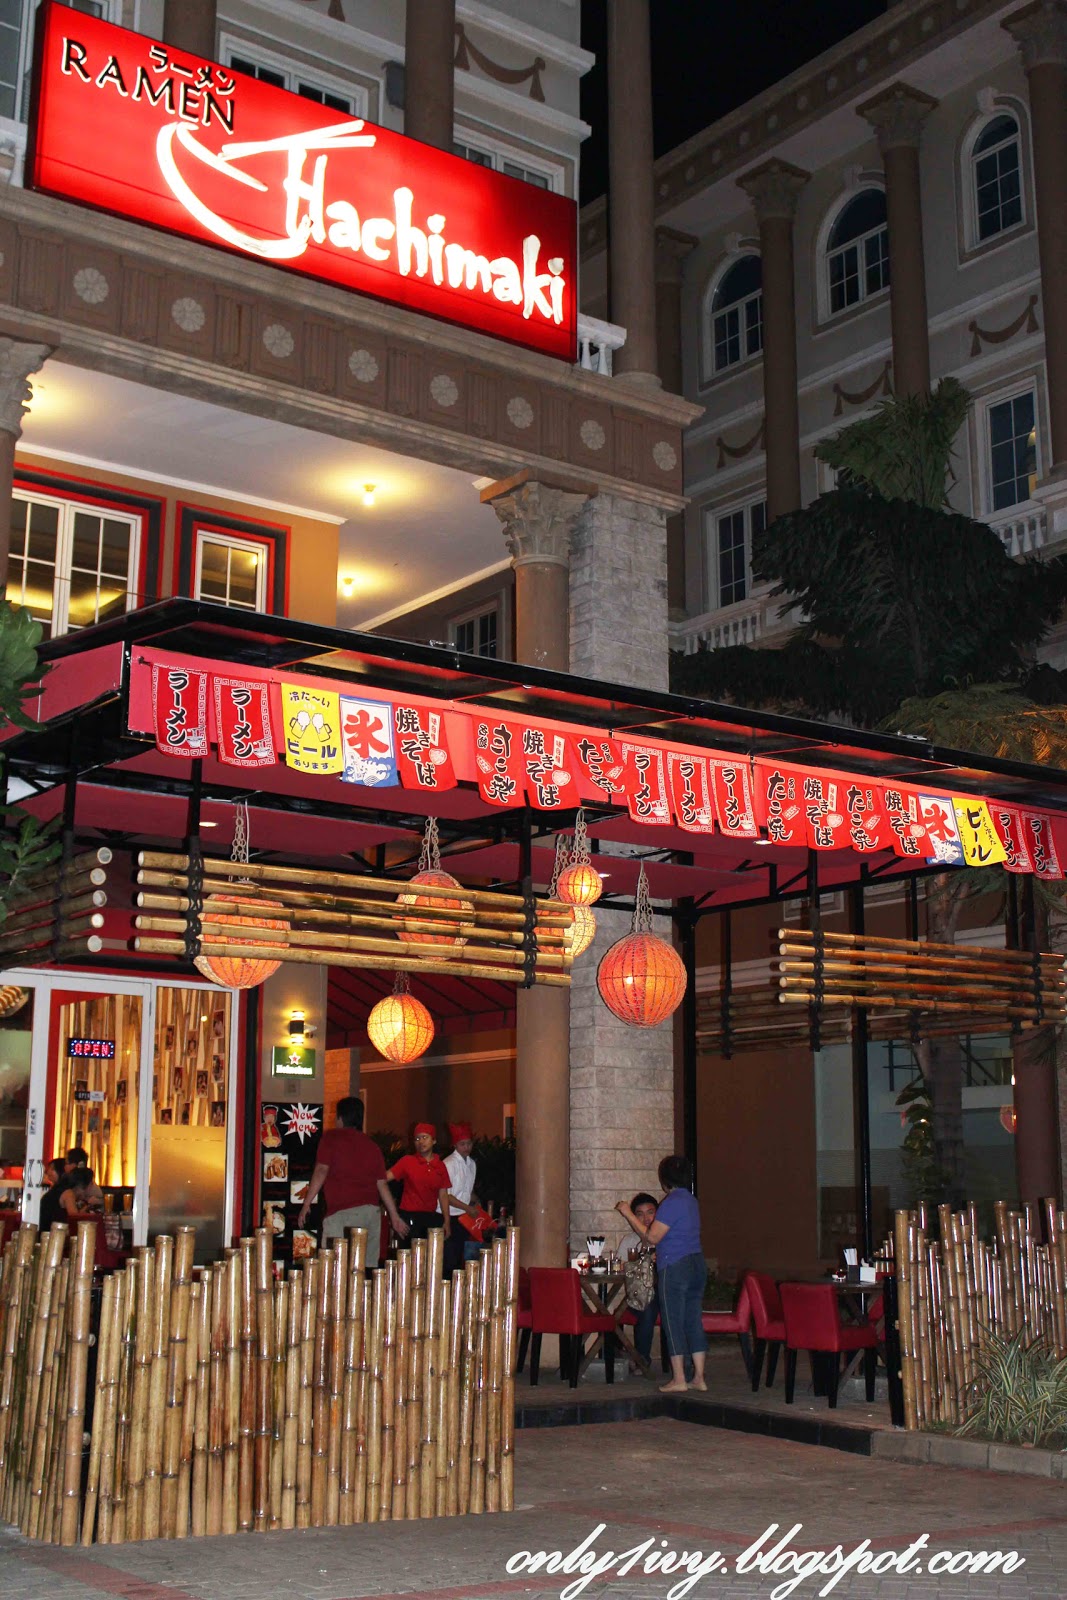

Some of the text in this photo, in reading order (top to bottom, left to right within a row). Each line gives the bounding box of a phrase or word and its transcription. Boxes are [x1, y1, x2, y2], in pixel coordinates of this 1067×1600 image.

[61, 37, 235, 135] RAMEN
[149, 45, 236, 95] ラーメン
[282, 148, 564, 325] Hachimaki
[166, 671, 189, 745] ラーメン
[231, 688, 256, 758] ラーメン
[344, 709, 389, 759] 氷
[287, 738, 337, 758] ビール
[395, 707, 437, 787] 焼きそば
[522, 728, 560, 807] 焼きそば
[634, 754, 652, 816] ラーメン
[680, 761, 697, 824] ラーメン
[722, 768, 740, 829] ラーメン
[804, 777, 834, 846] 焼きそば
[885, 790, 920, 855] 焼きそば
[922, 803, 955, 841] 氷
[967, 806, 992, 862] ビール
[999, 813, 1017, 866] ラーメン
[1030, 820, 1047, 873] ラーメン
[75, 1043, 109, 1055] OPEN
[288, 1121, 317, 1133] Menu
[293, 1109, 313, 1119] New
